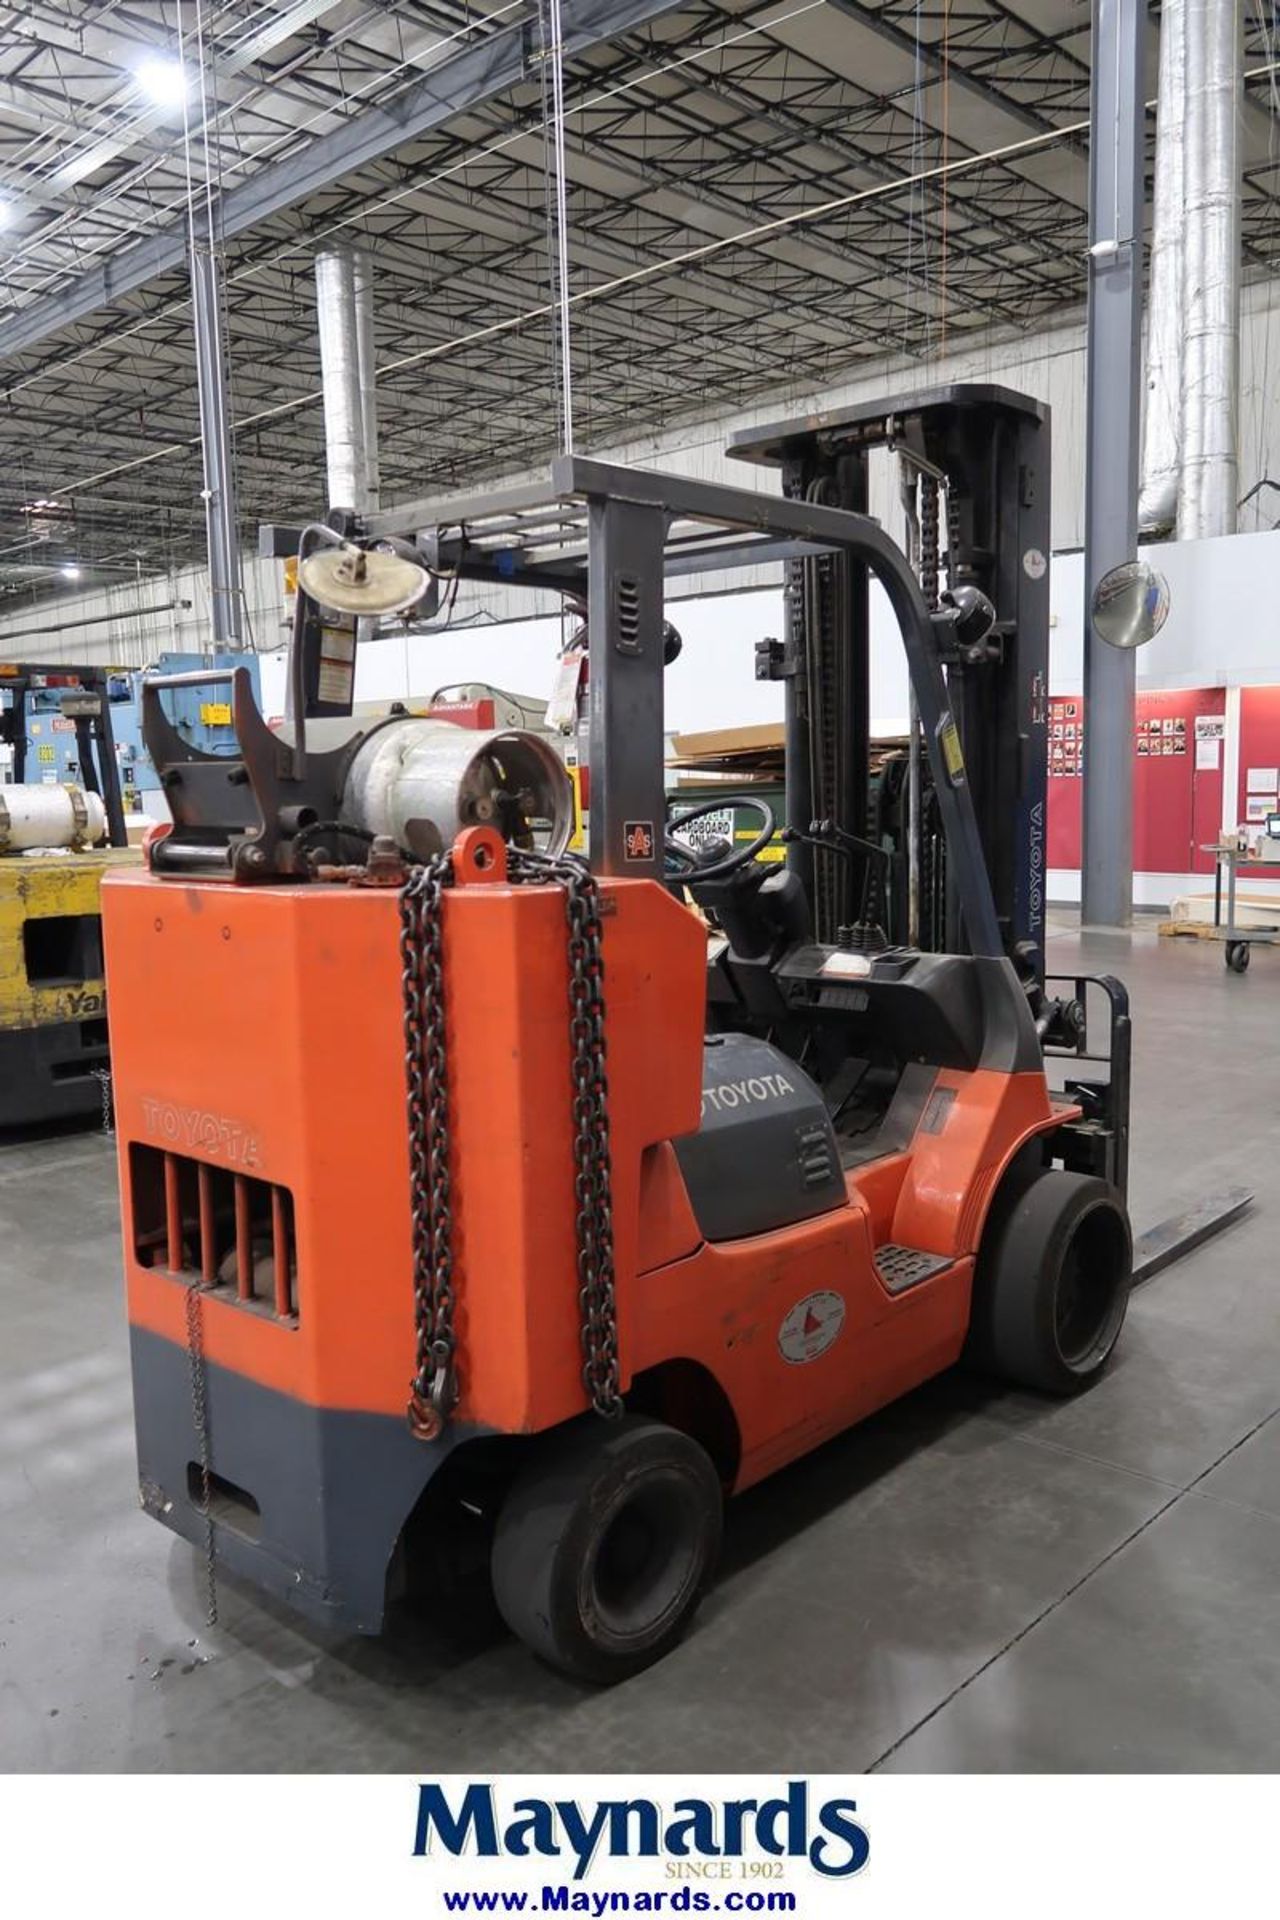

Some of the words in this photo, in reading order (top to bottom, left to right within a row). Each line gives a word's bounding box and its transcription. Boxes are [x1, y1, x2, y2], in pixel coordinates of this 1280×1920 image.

[1029, 800, 1042, 932] TOYOTA
[702, 1074, 794, 1111] TOYOTA
[141, 1097, 262, 1168] TOYOTA
